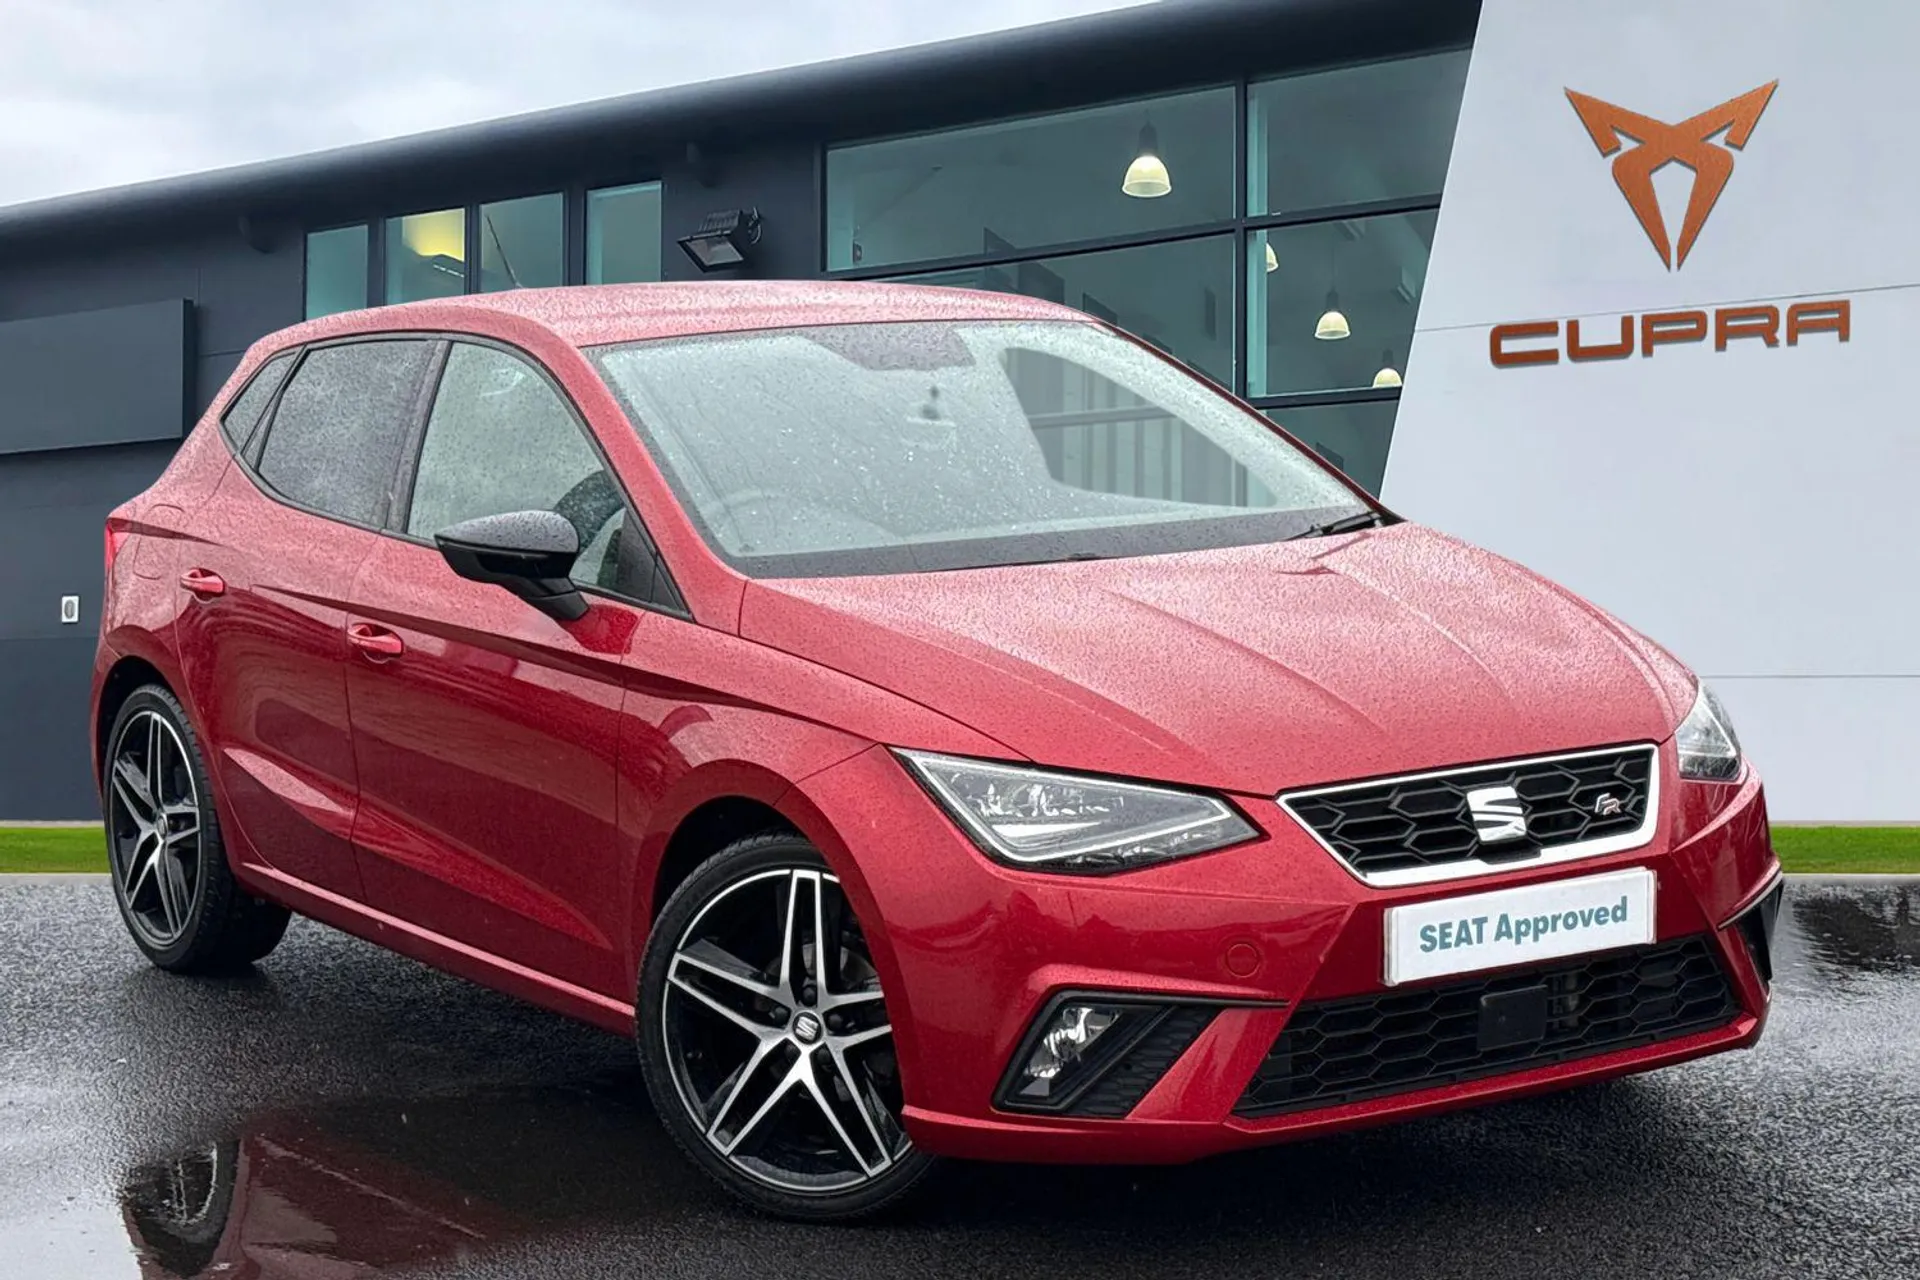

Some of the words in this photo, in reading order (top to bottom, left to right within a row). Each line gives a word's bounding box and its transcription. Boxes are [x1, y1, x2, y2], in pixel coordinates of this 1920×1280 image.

[1490, 300, 1850, 368] CUPRA
[1420, 917, 1488, 952] SEAT
[1494, 897, 1627, 943] Approved
